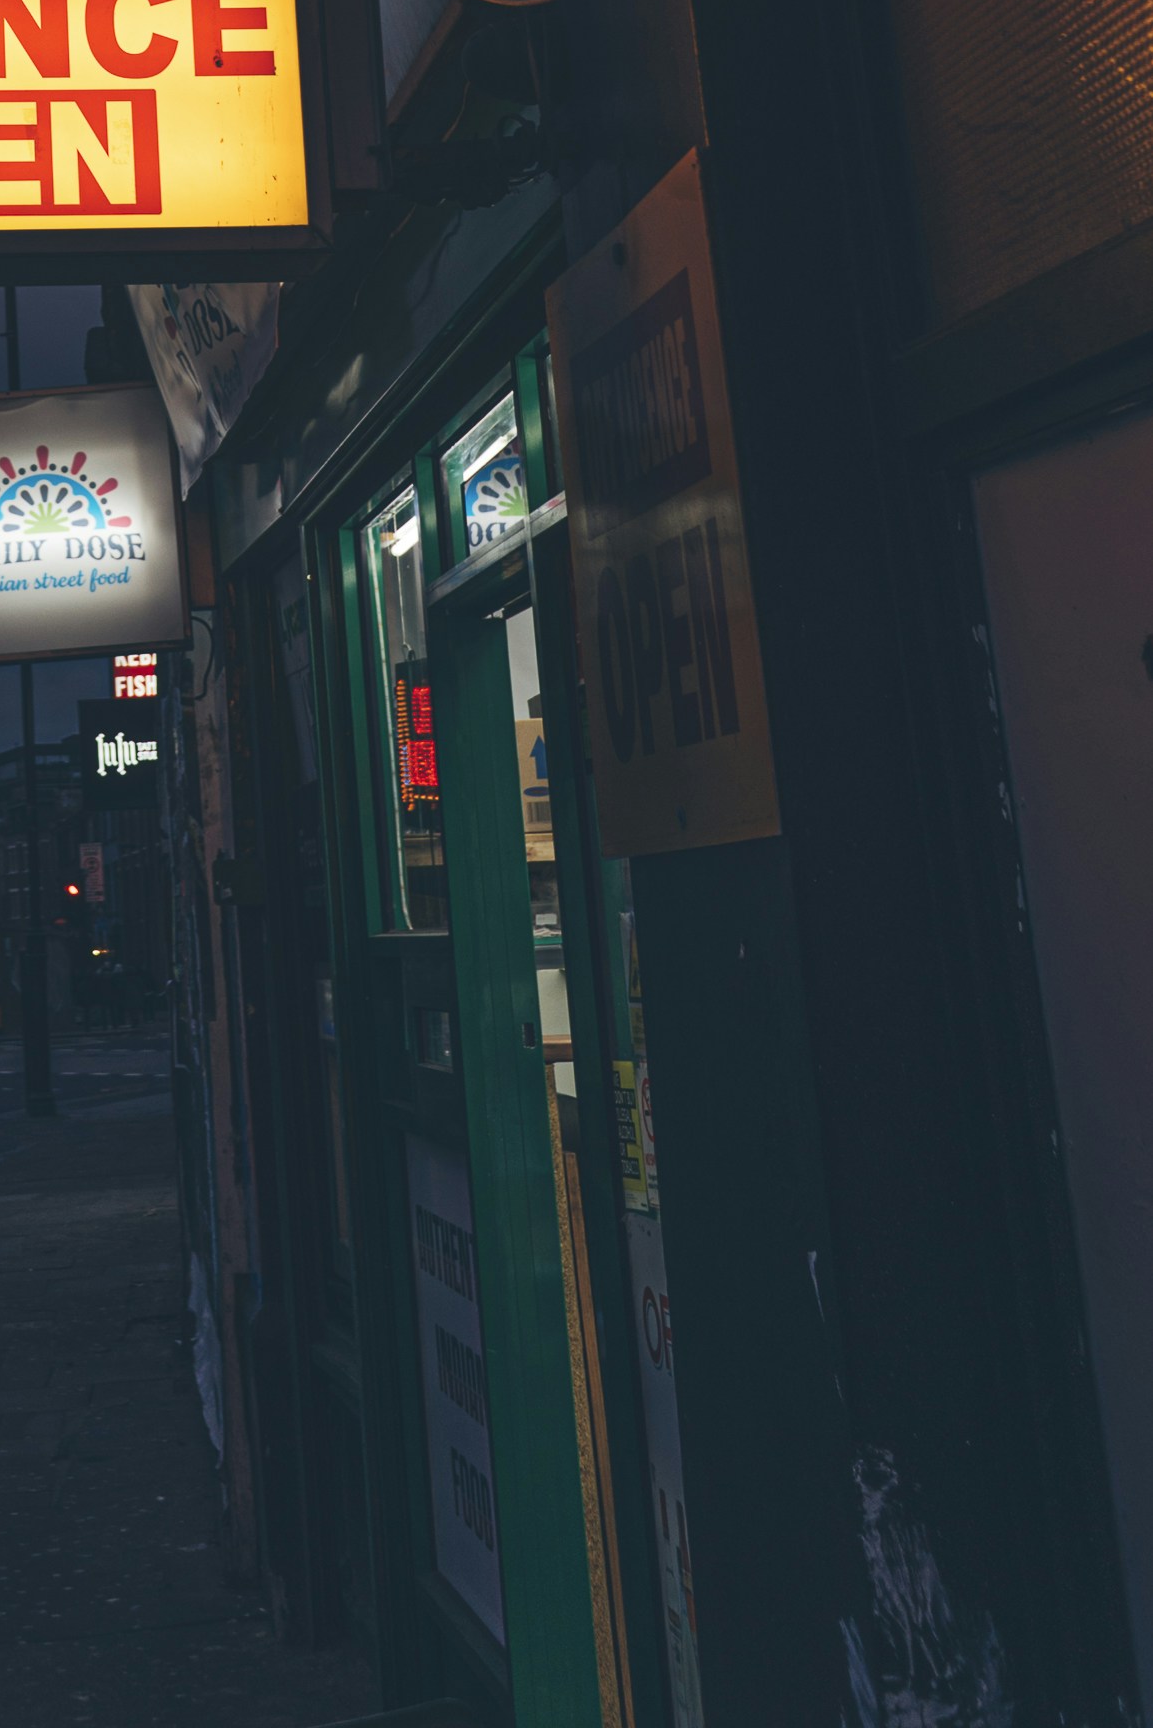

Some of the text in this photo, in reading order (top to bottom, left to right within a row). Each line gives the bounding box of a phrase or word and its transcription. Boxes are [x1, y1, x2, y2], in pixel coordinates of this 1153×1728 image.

[64, 532, 146, 561] DOSE
[34, 568, 86, 590] street
[89, 565, 132, 593] food
[597, 516, 741, 764] OPEN
[114, 674, 158, 698] FISH
[450, 1445, 495, 1553] FOOD
